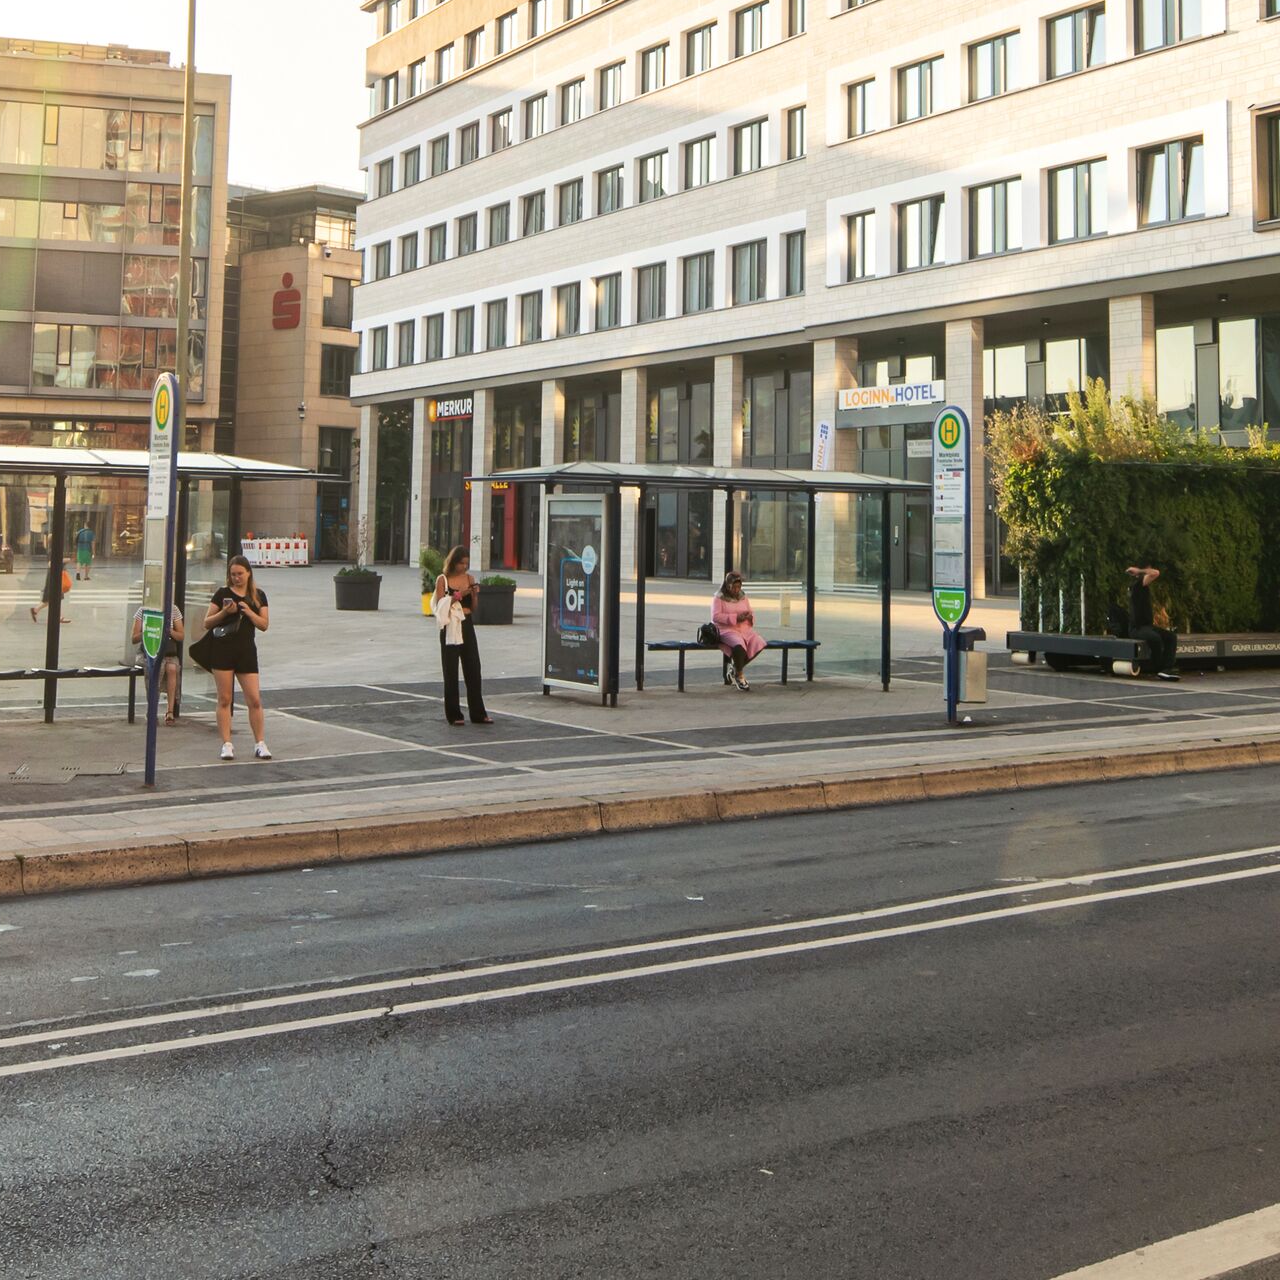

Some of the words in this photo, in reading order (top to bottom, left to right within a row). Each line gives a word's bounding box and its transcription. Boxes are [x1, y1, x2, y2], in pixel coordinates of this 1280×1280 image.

[437, 398, 472, 417] MERKUR
[566, 578, 578, 588] Light
[566, 589, 585, 612] OF
